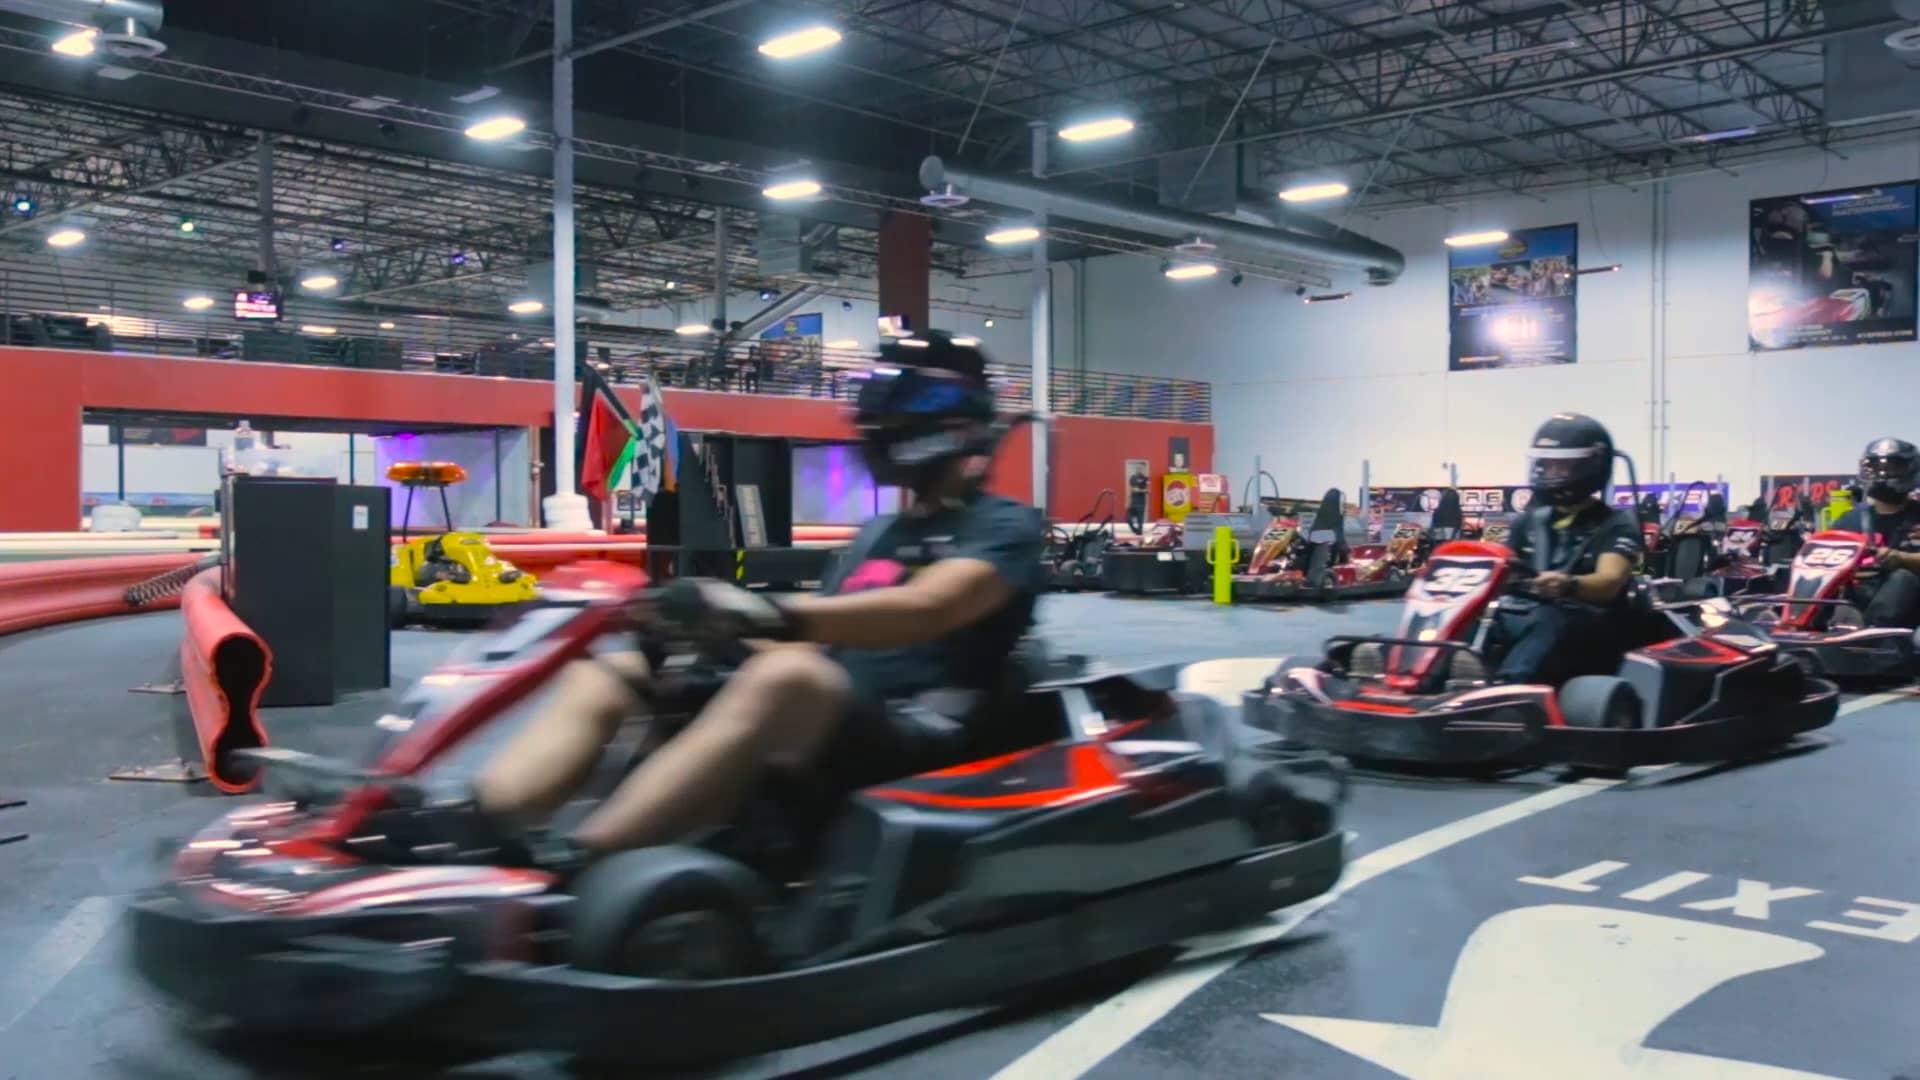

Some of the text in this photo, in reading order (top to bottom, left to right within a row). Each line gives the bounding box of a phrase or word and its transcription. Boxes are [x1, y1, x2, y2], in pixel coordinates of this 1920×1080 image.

[1803, 547, 1854, 566] 26
[1423, 567, 1492, 593] 32
[1516, 860, 1920, 942] EXIT
